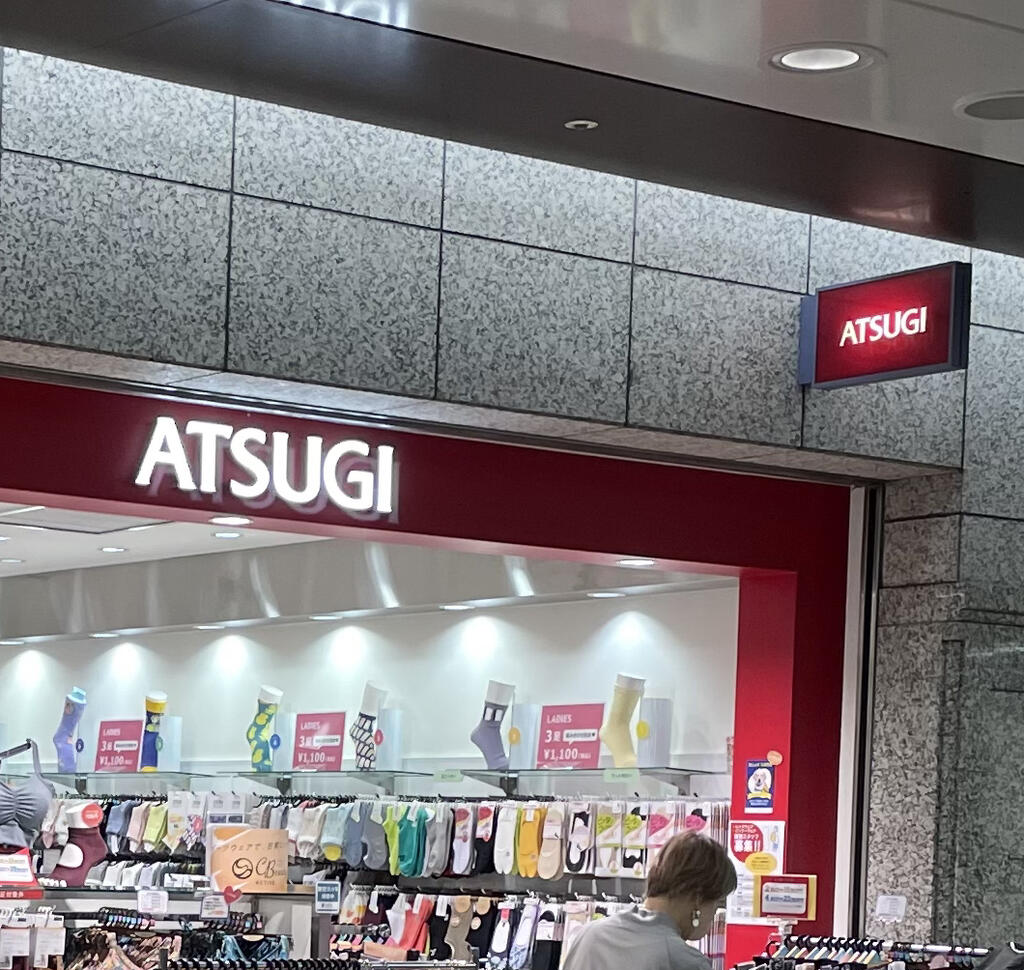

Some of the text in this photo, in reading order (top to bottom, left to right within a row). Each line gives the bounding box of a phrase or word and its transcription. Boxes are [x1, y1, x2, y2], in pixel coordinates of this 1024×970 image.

[839, 306, 927, 347] ATSUGI
[134, 416, 395, 513] ATSUGI
[547, 713, 573, 724] LADIES
